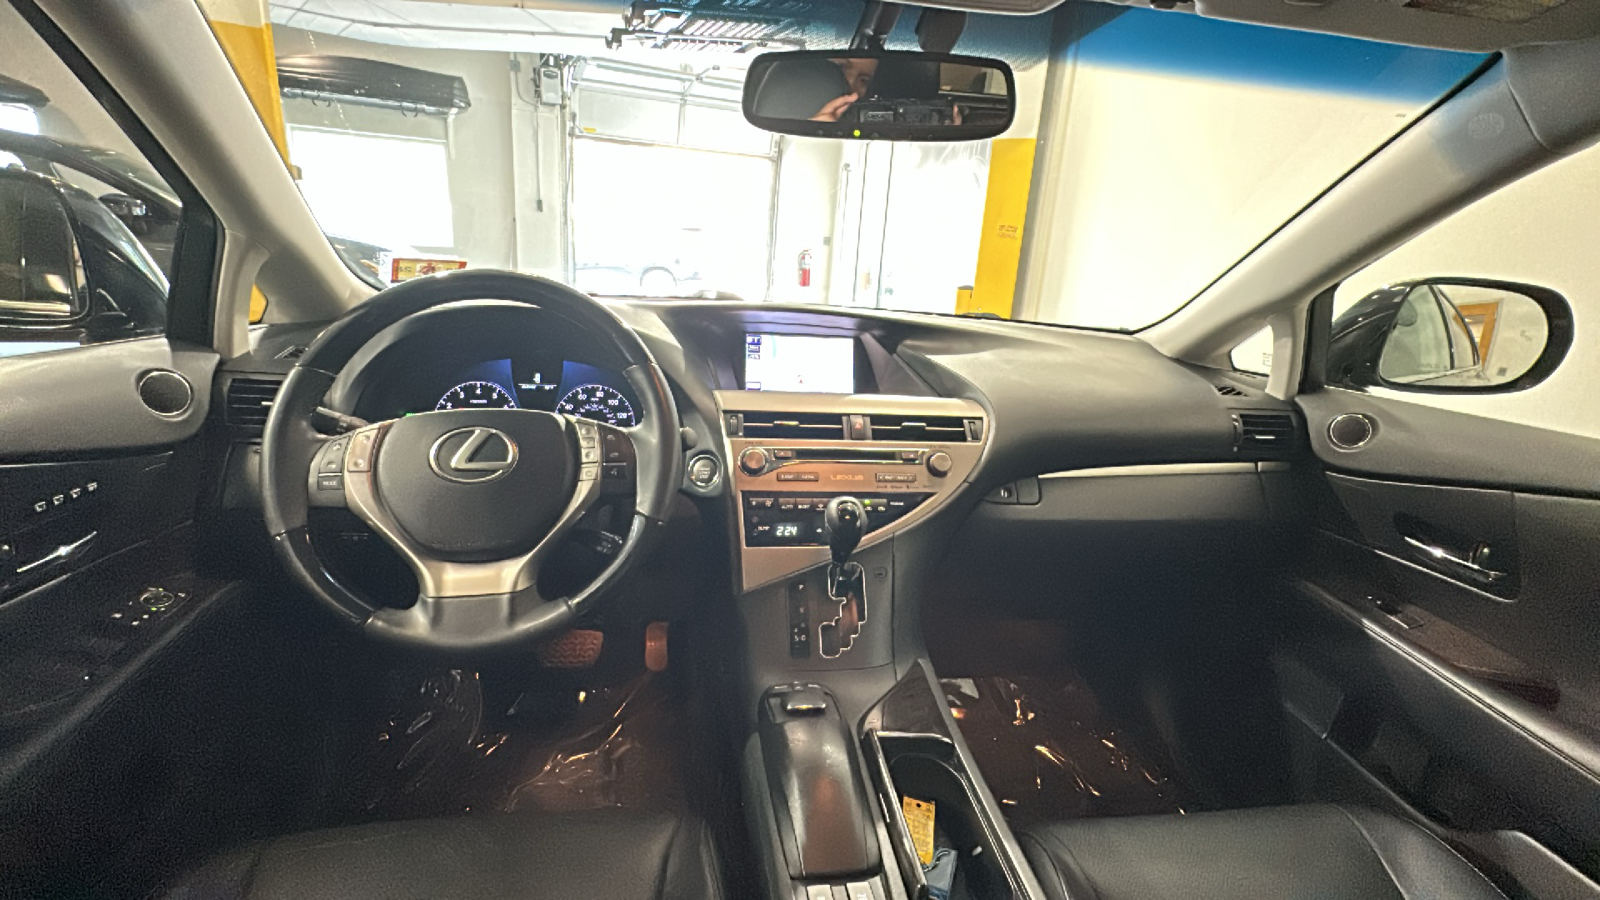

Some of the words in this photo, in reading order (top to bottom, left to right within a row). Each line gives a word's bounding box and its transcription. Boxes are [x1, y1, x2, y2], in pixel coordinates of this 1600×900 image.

[475, 387, 482, 395] 4
[577, 393, 588, 401] 60
[564, 403, 574, 411] 40
